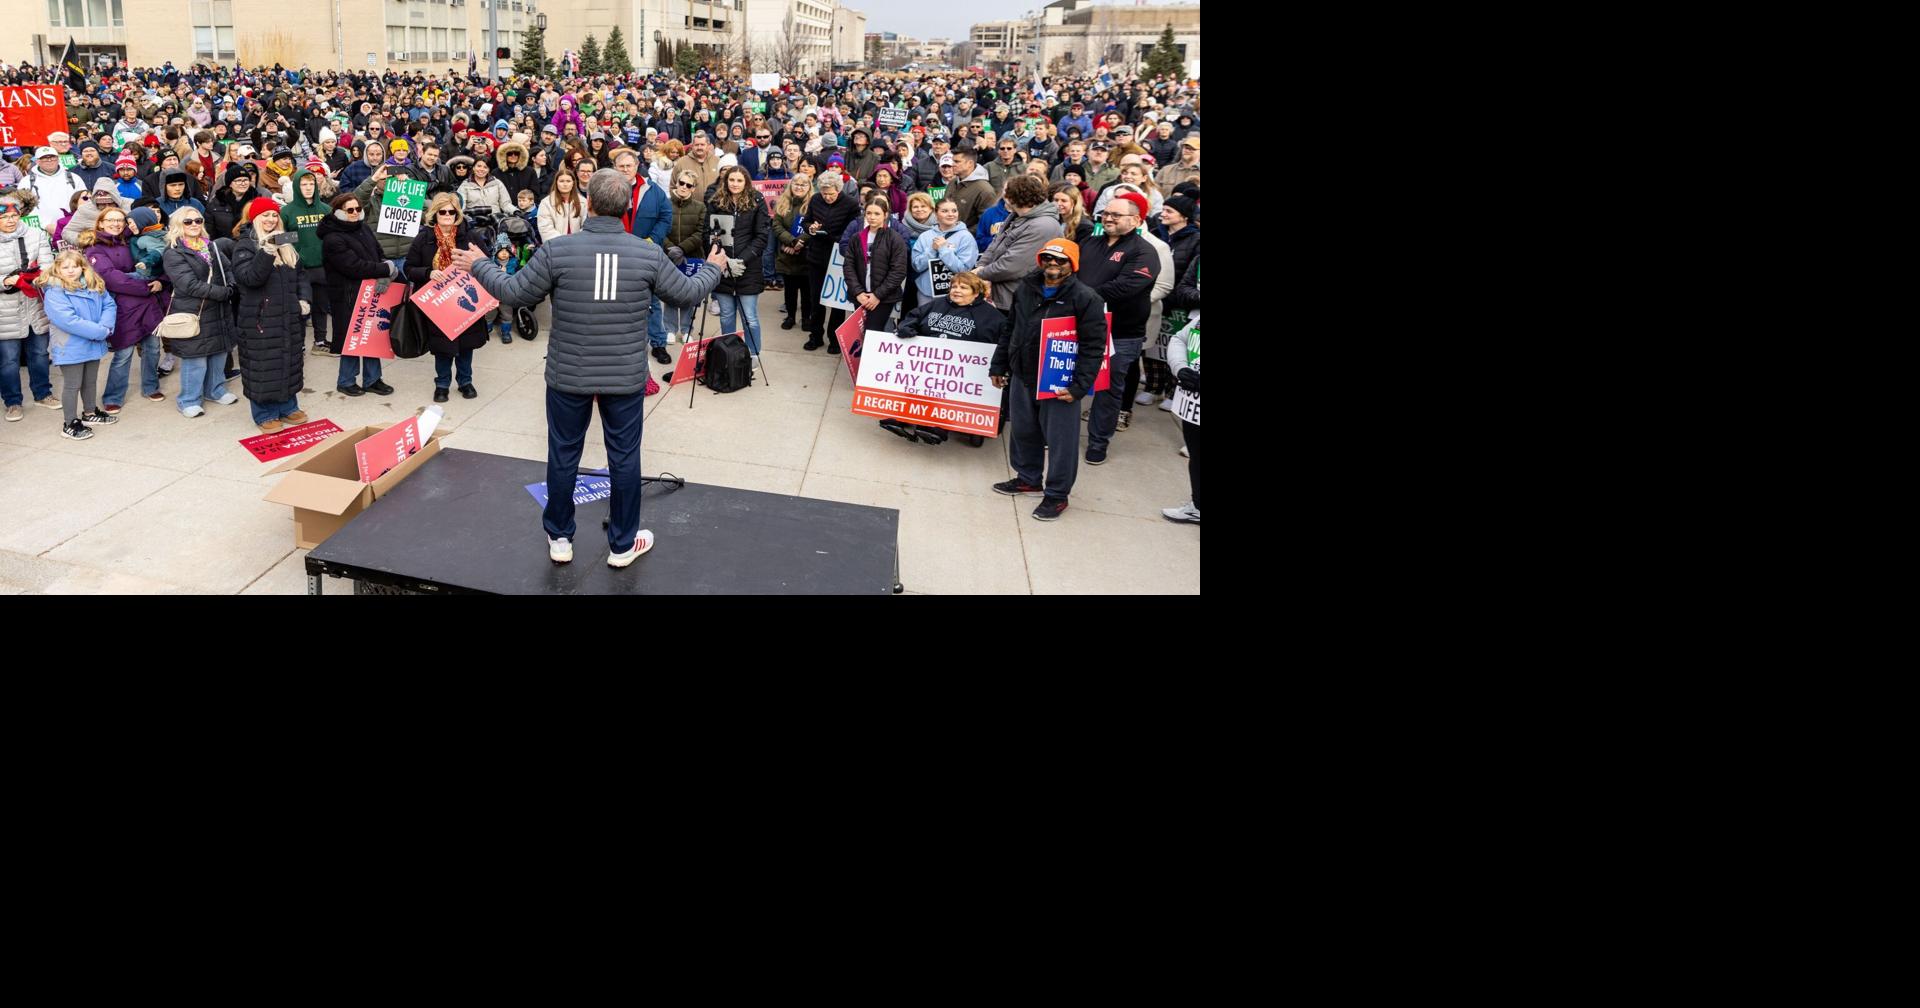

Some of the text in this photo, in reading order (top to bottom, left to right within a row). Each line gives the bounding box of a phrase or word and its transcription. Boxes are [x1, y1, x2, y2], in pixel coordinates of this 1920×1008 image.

[387, 179, 425, 197] LOVE LIFE
[384, 206, 418, 223] CHOOSE
[389, 221, 408, 235] LIFE
[932, 272, 954, 282] POS
[935, 282, 951, 290] GEN
[418, 288, 435, 304] WE
[431, 273, 472, 307] THEIR LIV
[821, 274, 849, 303] DIS
[348, 285, 374, 351] WE WALK FOR
[360, 292, 381, 345] THEIR LIVES
[928, 318, 973, 336] VISION
[878, 342, 988, 366] MY CHILD was
[895, 360, 965, 378] a VICTIM
[1049, 356, 1076, 371] The Un
[875, 371, 984, 397] of MY CHOICE
[904, 385, 947, 399] for that
[856, 395, 995, 428] I REGRET MY ABORTION
[289, 427, 338, 443] PRO-LIFE
[404, 424, 415, 446] WE
[395, 437, 406, 463] THE
